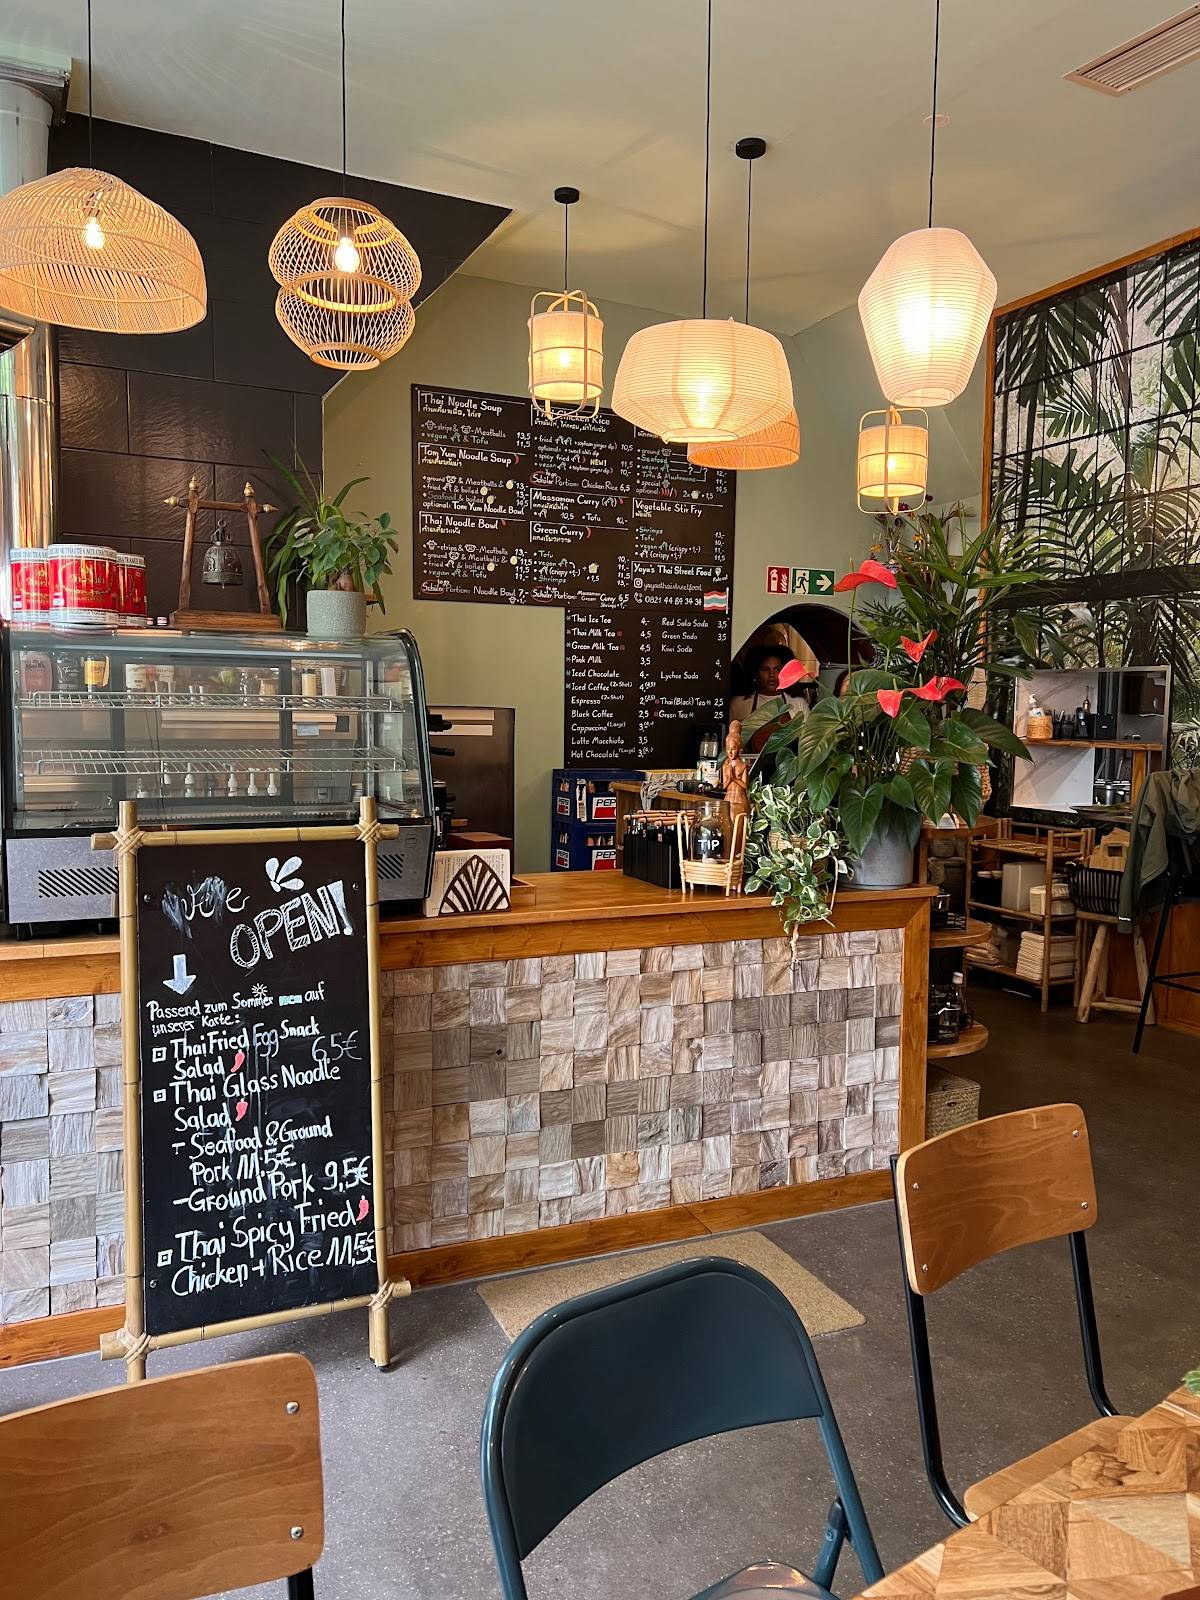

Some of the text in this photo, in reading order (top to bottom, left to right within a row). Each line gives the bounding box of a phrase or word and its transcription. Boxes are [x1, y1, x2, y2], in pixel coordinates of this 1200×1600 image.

[421, 393, 444, 405] Thai
[448, 396, 478, 410] Noodle
[480, 400, 502, 416] Soup
[592, 415, 610, 426] Rice
[426, 433, 488, 444] vegan Tofu
[516, 432, 531, 441] 13,5
[539, 434, 552, 443] fried
[621, 444, 634, 452] 10,5
[420, 445, 439, 459] Tom
[440, 446, 456, 458] Yum
[458, 449, 488, 462] Noodle
[490, 453, 512, 468] Soup
[538, 453, 608, 466] spicy fried NEW!
[641, 455, 668, 464] Seafood
[620, 460, 634, 469] 11,5
[642, 470, 656, 478] Tofu
[465, 478, 498, 488] Meatballs
[582, 478, 630, 492] Chicken Rice 6,5
[641, 479, 660, 487] special
[427, 483, 478, 494] fried boiled
[466, 494, 484, 504] boiled
[533, 491, 574, 504] Massaman
[576, 495, 600, 508] Curry
[452, 500, 467, 510] Tom
[468, 502, 482, 512] Yum
[484, 503, 507, 514] Noodle
[508, 506, 525, 515] Bowl
[635, 500, 702, 518] Vegetable Stir Fry
[560, 512, 574, 520] 10,5
[586, 512, 601, 522] Tofu
[422, 514, 498, 530] Thai Noodle Bowl
[533, 524, 558, 534] Green
[560, 526, 584, 540] Curry
[640, 526, 664, 535] Shrimps
[640, 534, 654, 542] Tofu
[428, 552, 500, 564] ground Meatballs
[538, 550, 554, 558] Tofu
[428, 560, 486, 570] fried boiled
[538, 560, 556, 568] vegan
[634, 562, 712, 576] Yaya's Thai Street Food
[428, 570, 487, 578] vegan Tofu
[538, 574, 566, 585] Shrimps
[473, 586, 516, 597] Noodle Bowl
[600, 594, 630, 604] Curry 6,5
[644, 596, 662, 604] 0821
[572, 614, 612, 624] Thai Ice Tea
[662, 617, 709, 628] Red Sala Soda
[717, 620, 728, 629] 3,5
[572, 627, 616, 638] Thai Milk Tea
[640, 630, 652, 640] 4,5
[662, 630, 698, 640] Green Soda
[572, 641, 619, 651] Green Milk Tea
[640, 644, 651, 652] 4,5
[662, 644, 692, 653] Kiwi Soda
[572, 654, 602, 664] Pink Milk
[640, 656, 651, 666] 3,5
[572, 668, 620, 678] Iced Chocolate
[660, 671, 699, 682] Lychee Soda
[572, 682, 610, 691] Iced Coffee
[571, 695, 601, 706] Espresso
[660, 696, 673, 706] Thai
[695, 698, 706, 706] Tea
[714, 698, 724, 708] 2,5
[571, 709, 614, 718] Black Coffee
[638, 710, 650, 720] 2,5
[658, 710, 688, 718] Green Tea
[714, 711, 724, 720] 2,5
[572, 723, 608, 734] Cappuccino
[571, 736, 625, 745] Latte Macchiato
[638, 736, 648, 746] 3,5
[571, 750, 620, 759] Hot Chocolate
[698, 840, 720, 851] TIP
[229, 879, 354, 970] OPEN!
[147, 1000, 200, 1022] Passend
[204, 1002, 228, 1014] zum
[231, 992, 274, 1010] Sommer
[304, 981, 325, 1002] auf
[152, 1014, 241, 1037] unserer Karte:
[170, 1016, 320, 1059] Thai Fried Egg Snack
[173, 1055, 226, 1081] Salad
[170, 1058, 341, 1105] Thai Glass Noodle
[174, 1102, 233, 1132] Salad
[189, 1115, 334, 1160] Seafood & Ground
[189, 1157, 233, 1186] Pork
[269, 1163, 316, 1203] Pork
[322, 1156, 372, 1192] 9,5€
[174, 1198, 357, 1263] Thai Spicy Fried
[171, 1257, 249, 1298] Chicken
[267, 1242, 324, 1277] Rice
